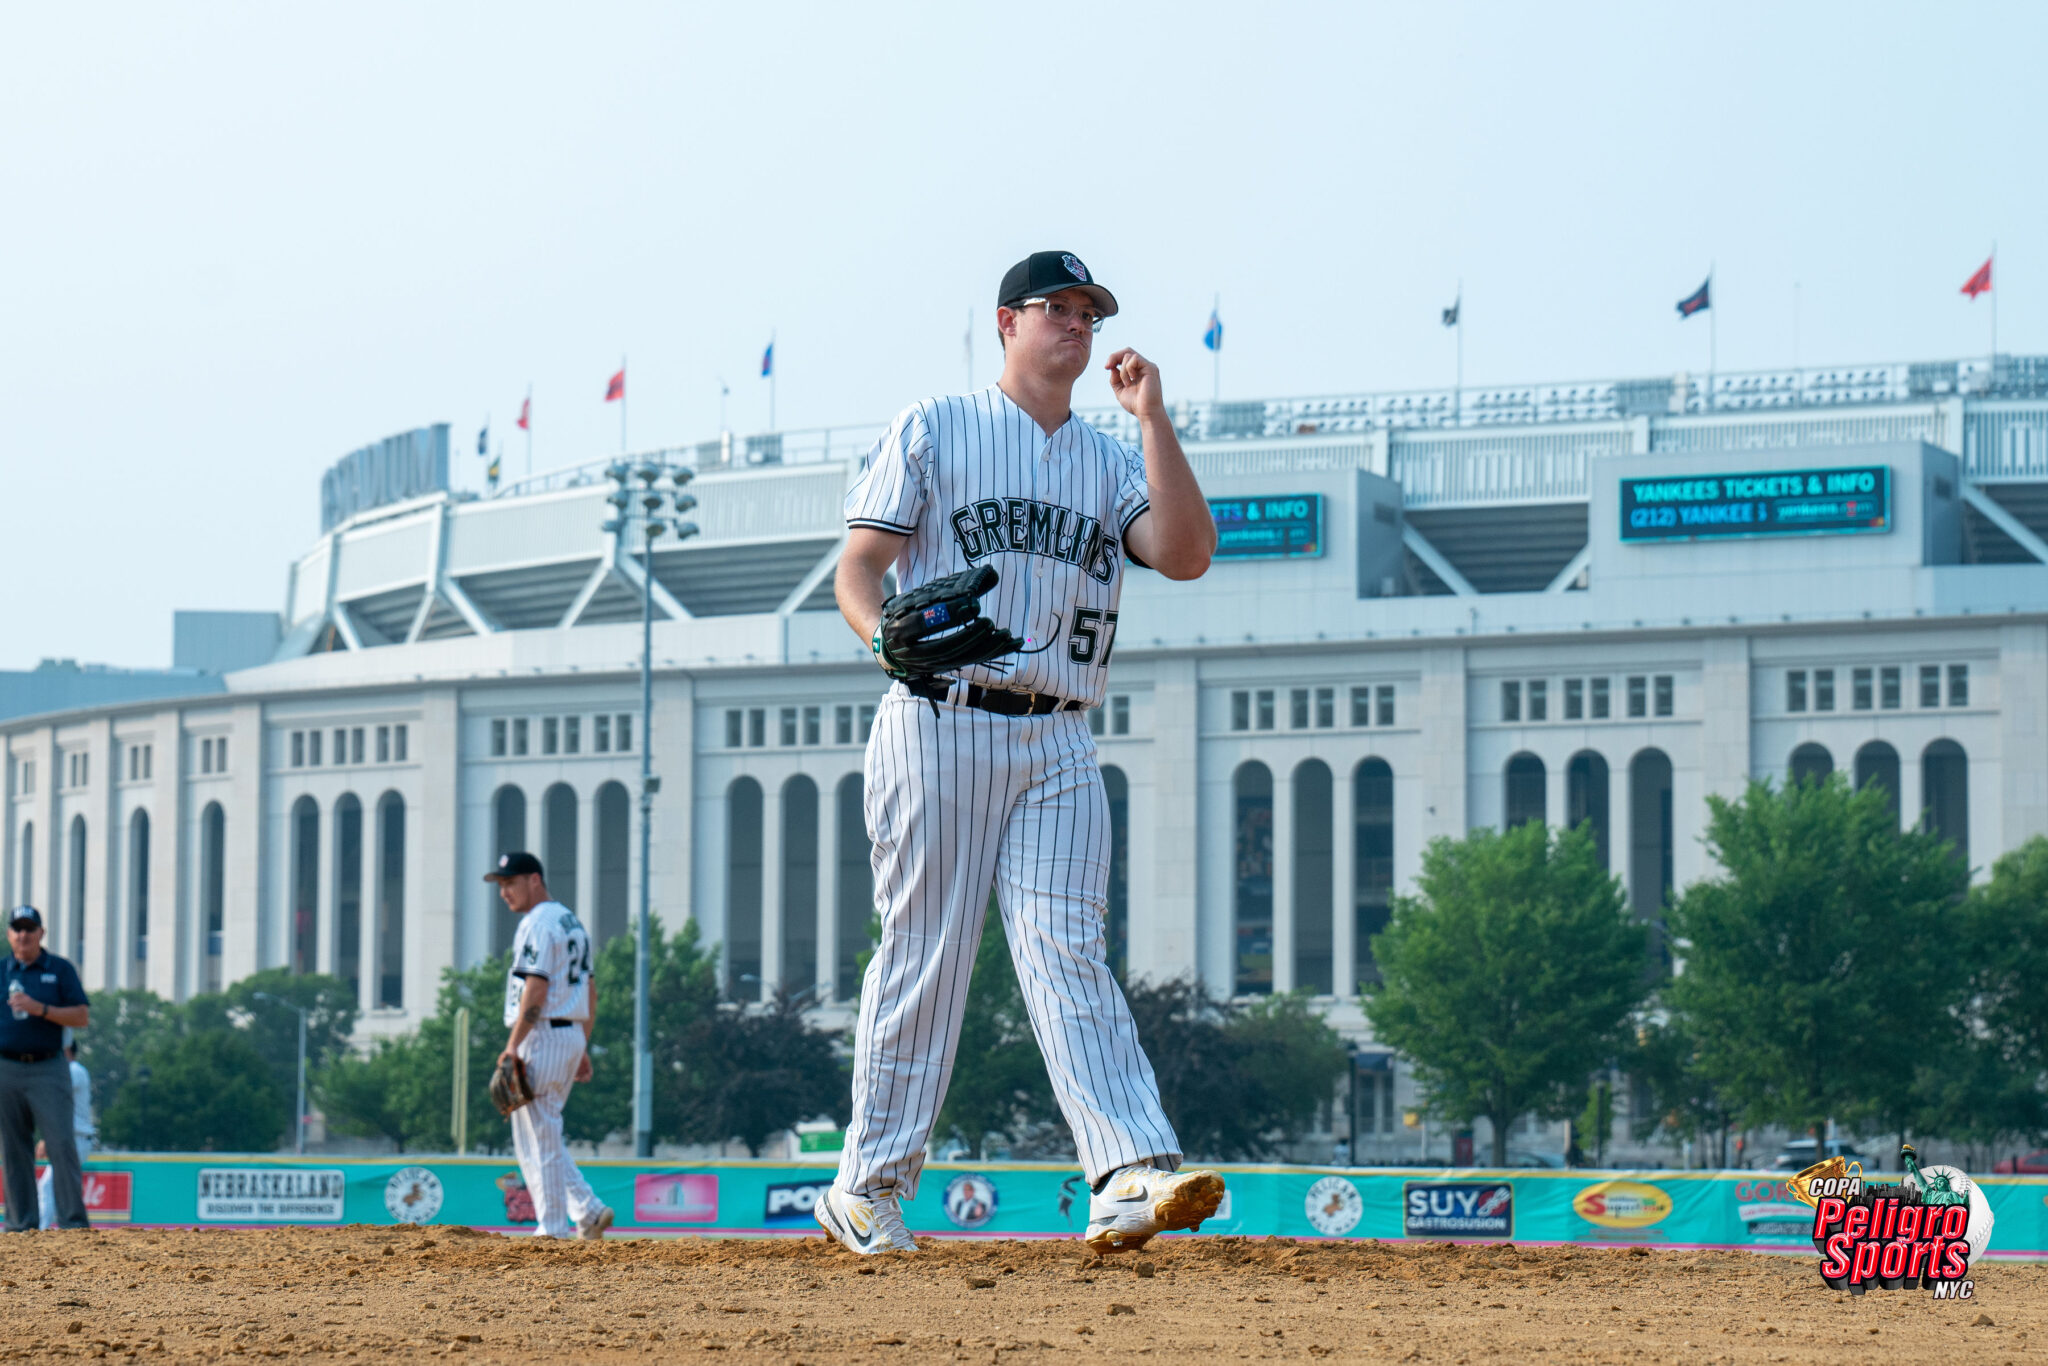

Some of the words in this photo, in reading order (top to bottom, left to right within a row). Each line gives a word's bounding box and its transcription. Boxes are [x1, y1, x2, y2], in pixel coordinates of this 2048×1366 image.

[1633, 481, 1719, 502] YANKEES
[1723, 476, 1803, 498] TICKETS
[1808, 474, 1823, 494] &
[1827, 472, 1875, 492] INFO
[1246, 502, 1260, 520] &
[1265, 500, 1308, 519] INFO
[1630, 506, 1677, 529] (212)
[950, 497, 1119, 584] GREMLINS
[1068, 606, 1119, 668] 57
